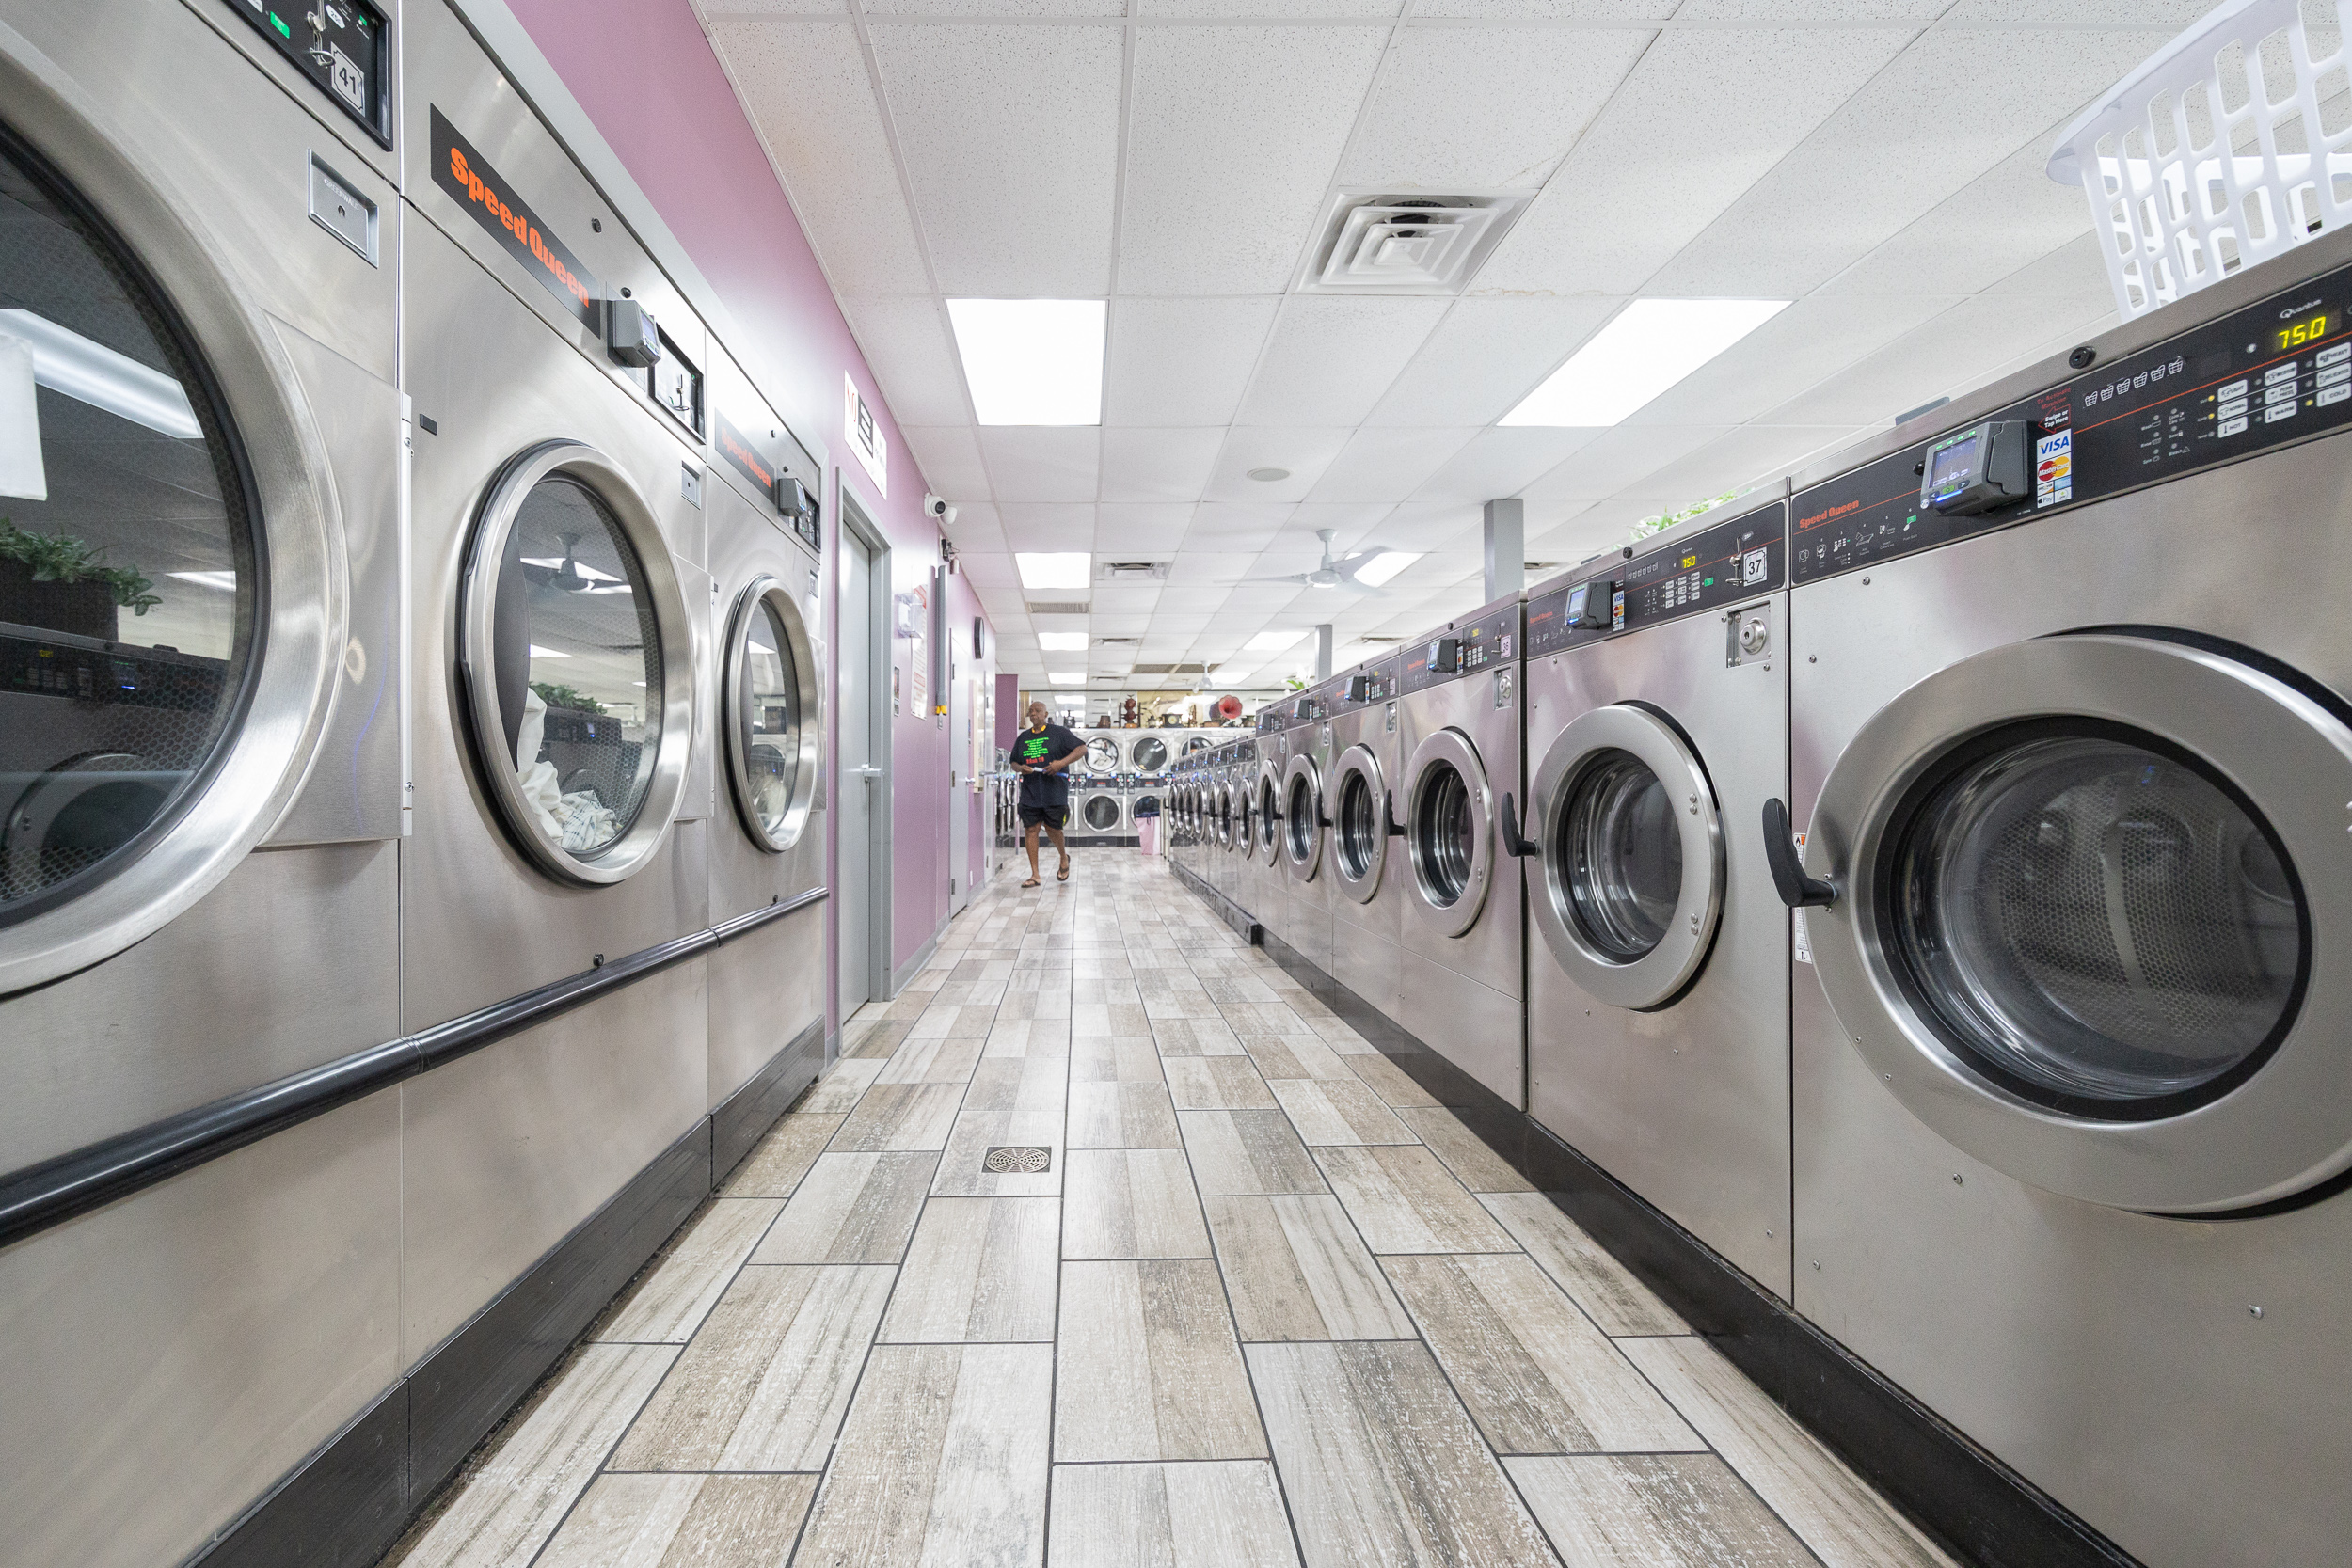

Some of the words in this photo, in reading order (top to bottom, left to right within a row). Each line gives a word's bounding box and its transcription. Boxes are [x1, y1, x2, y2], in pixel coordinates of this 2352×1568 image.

[339, 67, 357, 95] 41
[451, 147, 527, 246] Speed
[529, 227, 589, 308] Queen
[2280, 299, 2322, 319] Quantum
[2279, 316, 2326, 349] 750
[2328, 388, 2347, 399] COLD
[2044, 412, 2061, 422] Swipe
[2056, 416, 2069, 424] Here
[2039, 436, 2070, 455] VISA
[1799, 510, 1827, 529] Speed
[1829, 499, 1860, 517] Queen
[1682, 555, 1696, 569] 750
[1748, 559, 1762, 576] 37
[1613, 594, 1624, 602] VISA
